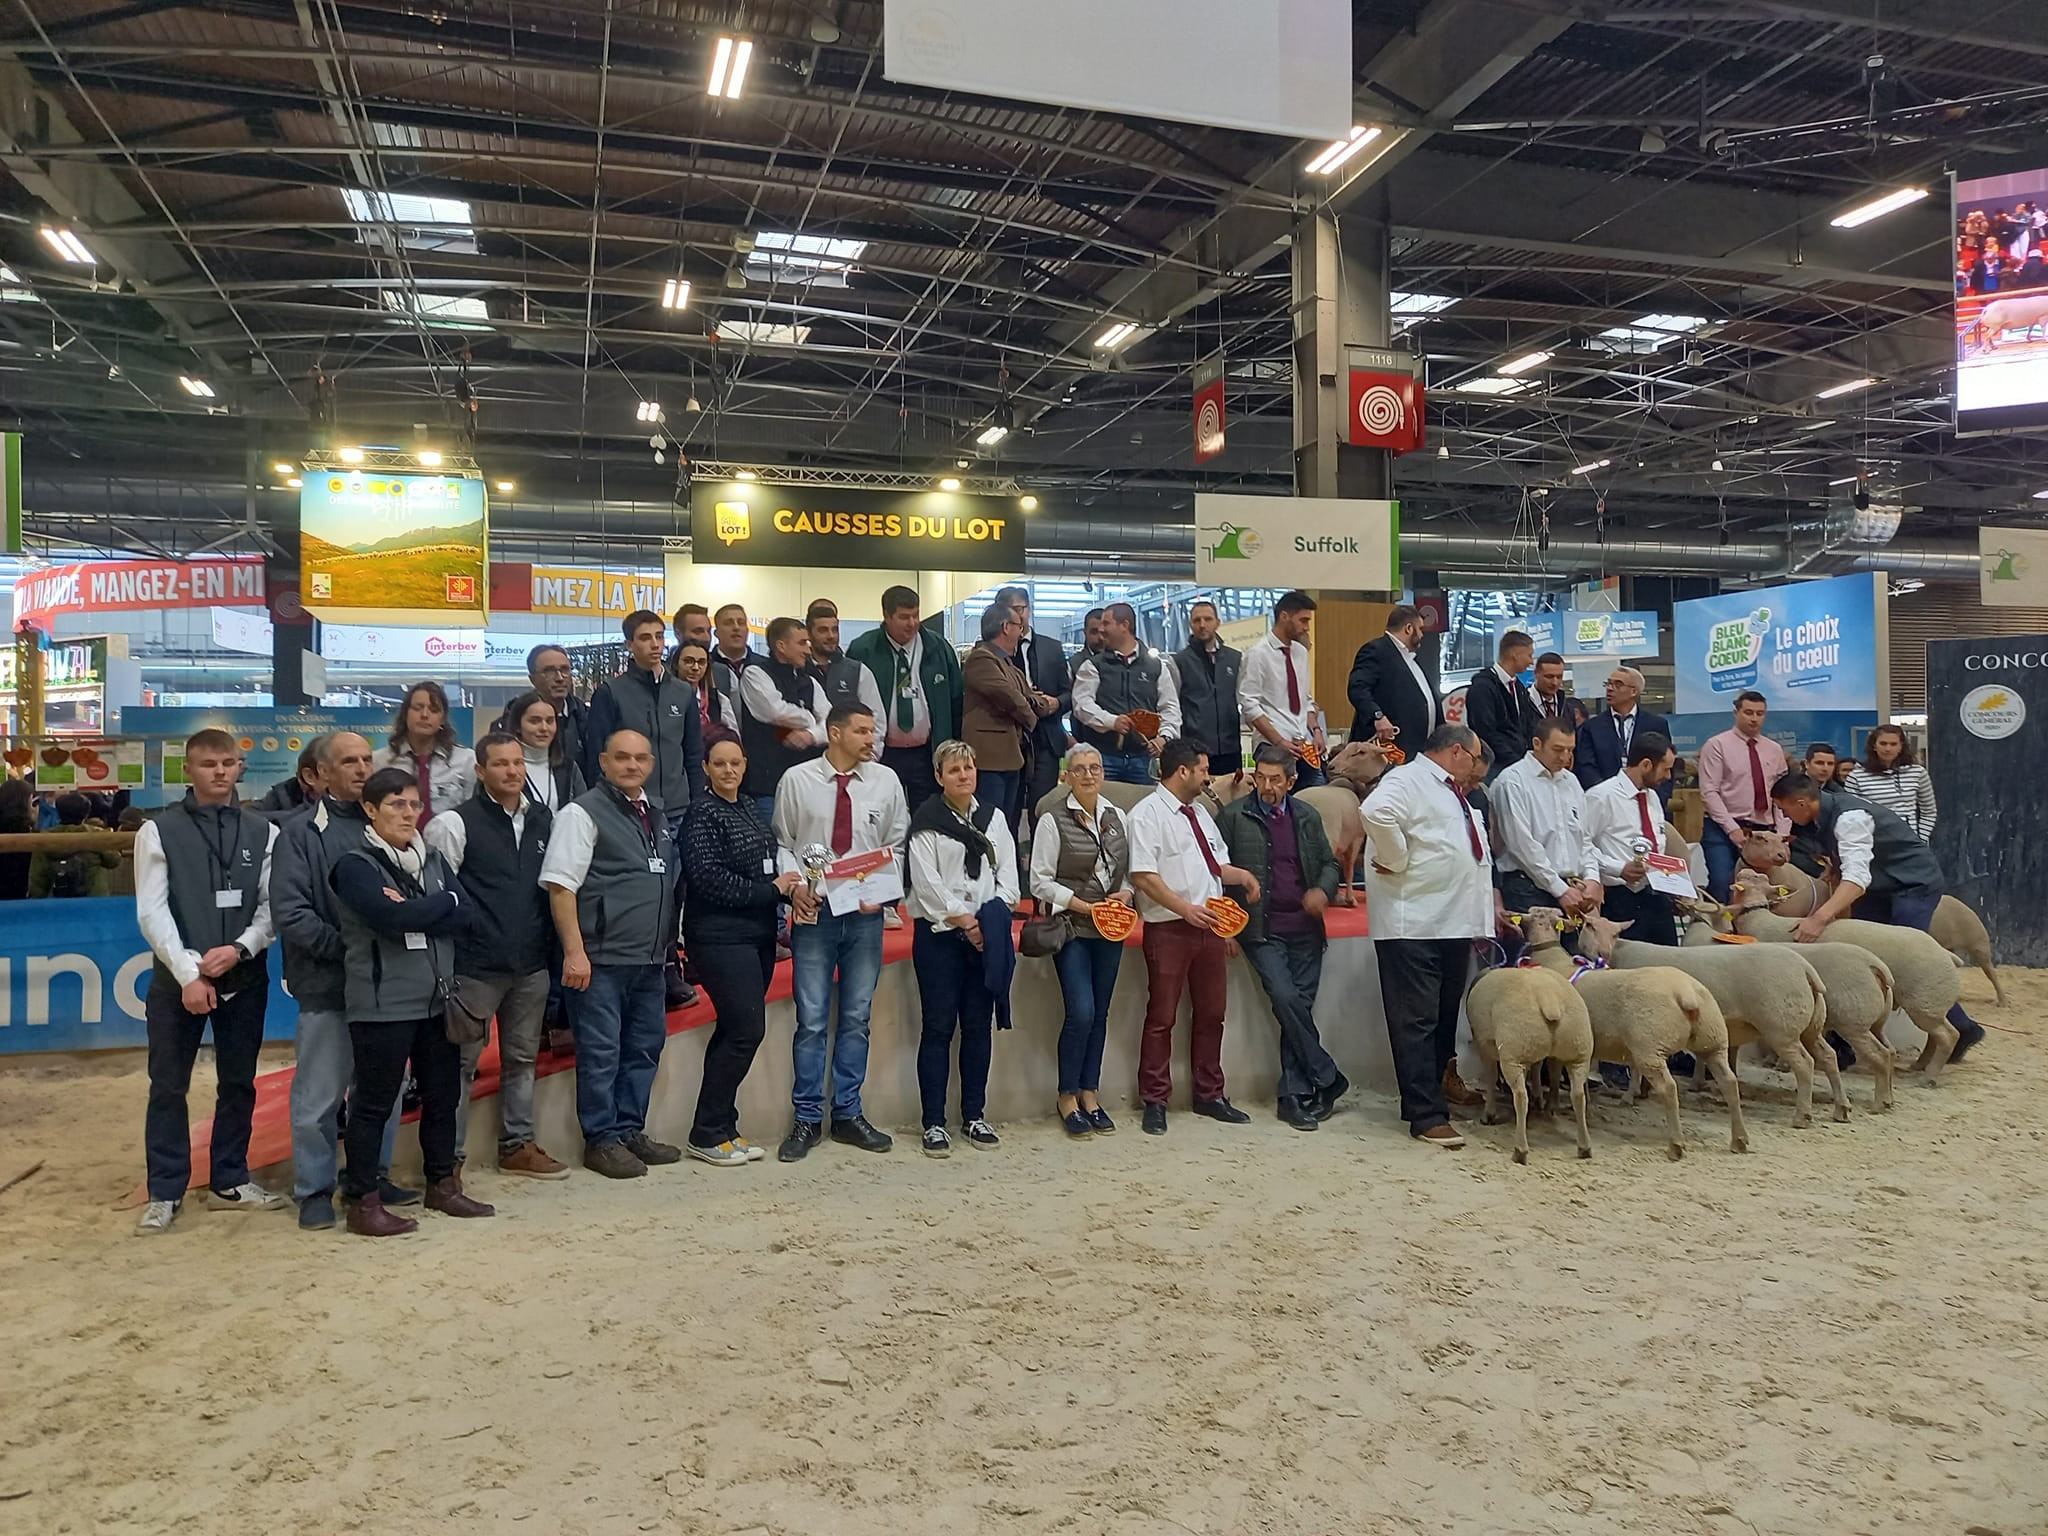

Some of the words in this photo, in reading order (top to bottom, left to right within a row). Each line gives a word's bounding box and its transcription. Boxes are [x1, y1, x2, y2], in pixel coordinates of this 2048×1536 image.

[1369, 354, 1393, 366] 1116
[773, 508, 902, 537] CAUSSES
[908, 514, 947, 539] DU
[953, 518, 1006, 541] LOT
[1294, 535, 1359, 554] Suffolk
[90, 566, 225, 604] MANGEZ-EN
[533, 575, 592, 608] IMEZ
[598, 581, 627, 612] LA
[1715, 622, 1745, 640] BLEU
[1775, 626, 1793, 651] Le
[1796, 613, 1841, 647] choix
[430, 641, 477, 651] interbev
[1712, 634, 1751, 654] BLANC
[1709, 648, 1750, 669] COEUR
[1773, 651, 1793, 675] du
[1796, 643, 1840, 671] cœur
